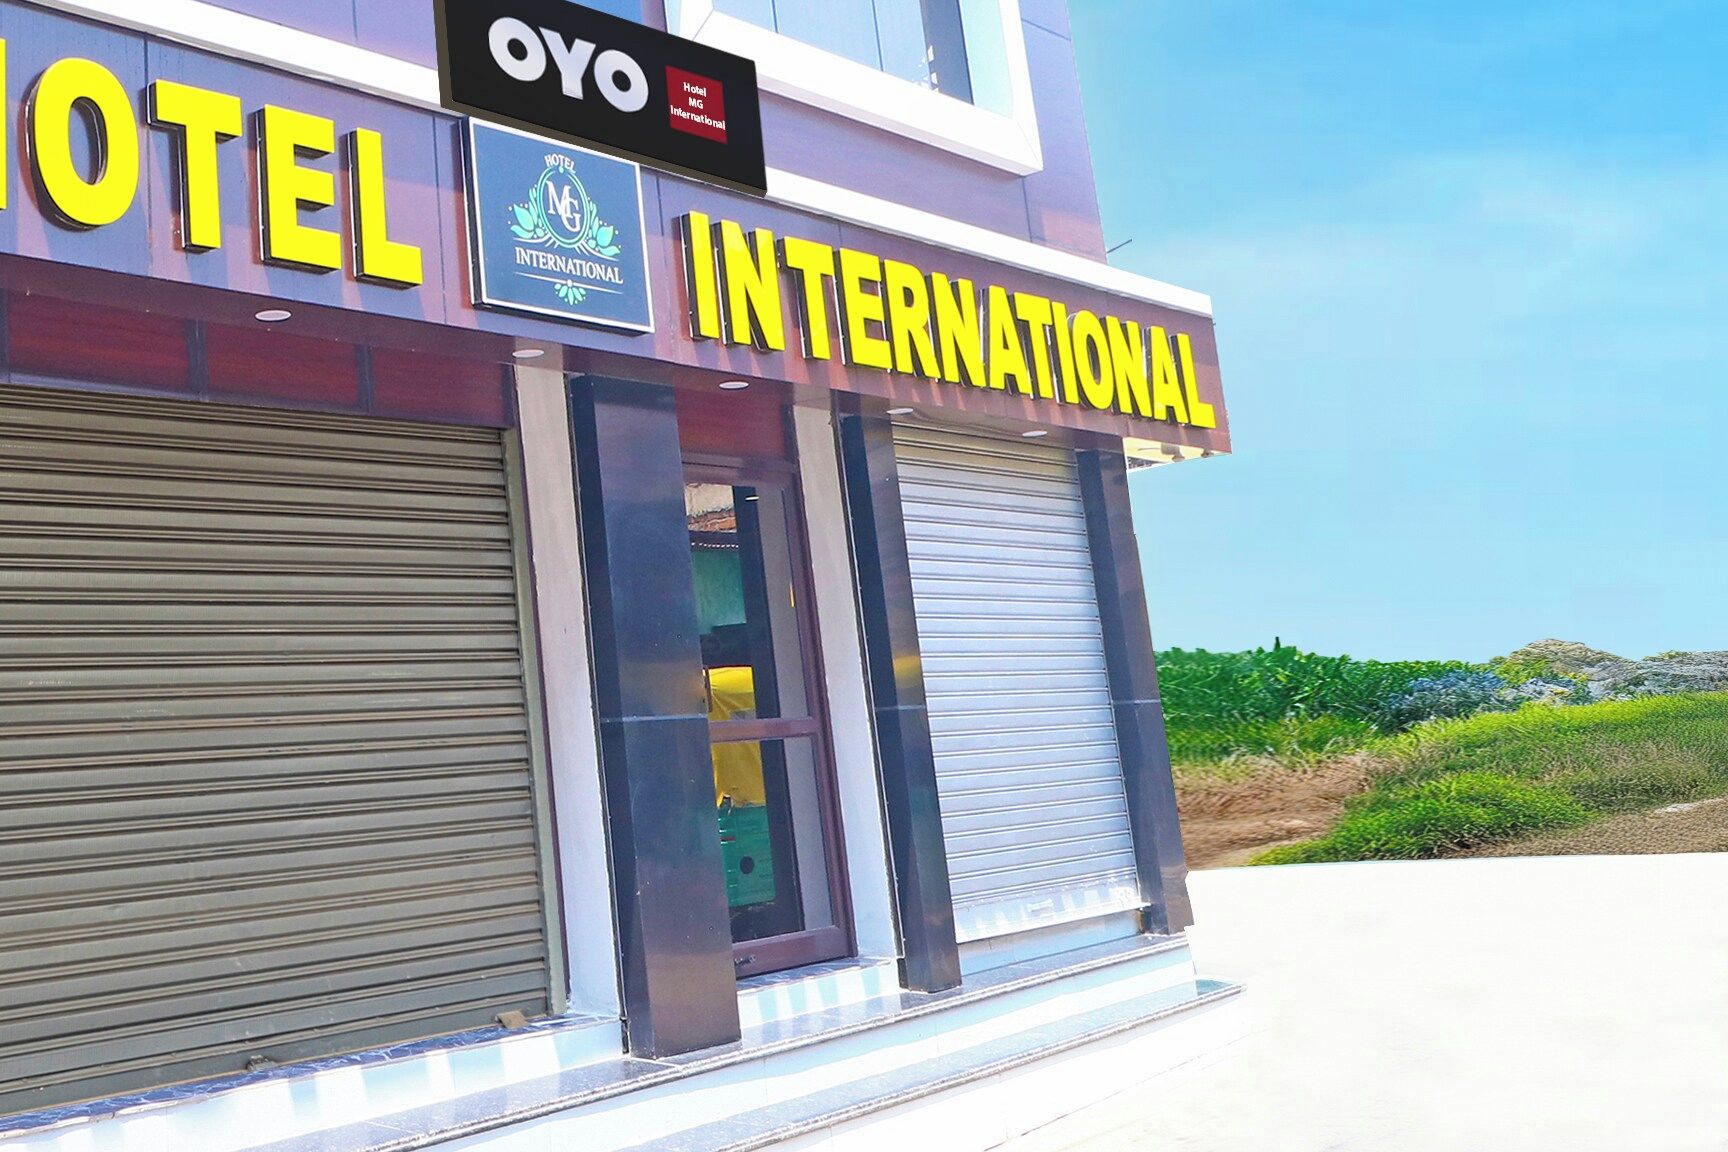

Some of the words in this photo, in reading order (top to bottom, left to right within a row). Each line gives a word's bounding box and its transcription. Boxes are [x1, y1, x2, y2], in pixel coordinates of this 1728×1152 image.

[488, 16, 649, 113] OYO
[683, 81, 707, 97] Hotel
[688, 96, 704, 109] MG
[670, 104, 726, 131] International
[544, 153, 576, 174] HOTEL
[546, 180, 582, 233] MG
[515, 247, 624, 284] INTERNATIONAL
[685, 210, 1216, 429] INTERNATIONAL
